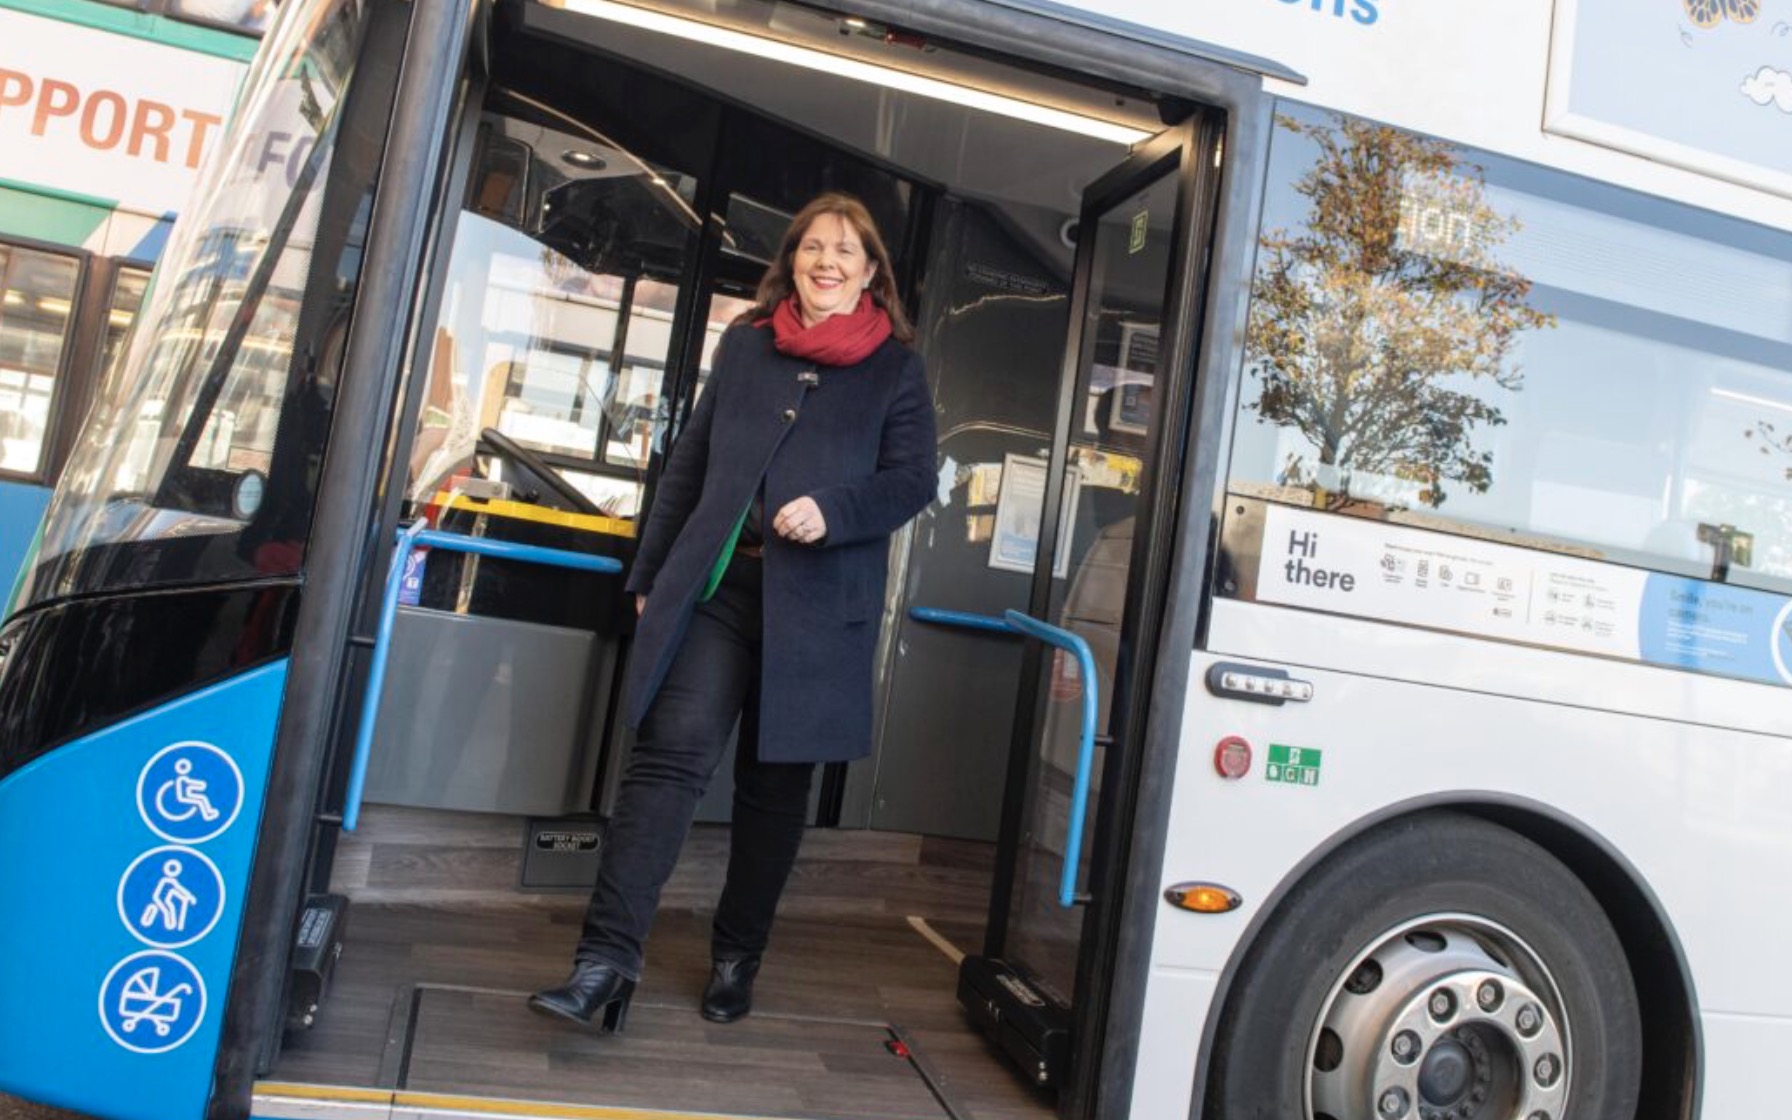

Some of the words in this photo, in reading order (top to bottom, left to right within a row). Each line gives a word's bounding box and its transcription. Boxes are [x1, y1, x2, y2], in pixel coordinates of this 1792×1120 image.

[0, 68, 221, 169] PPORT
[1288, 530, 1318, 558] Hi
[1284, 558, 1356, 592] there
